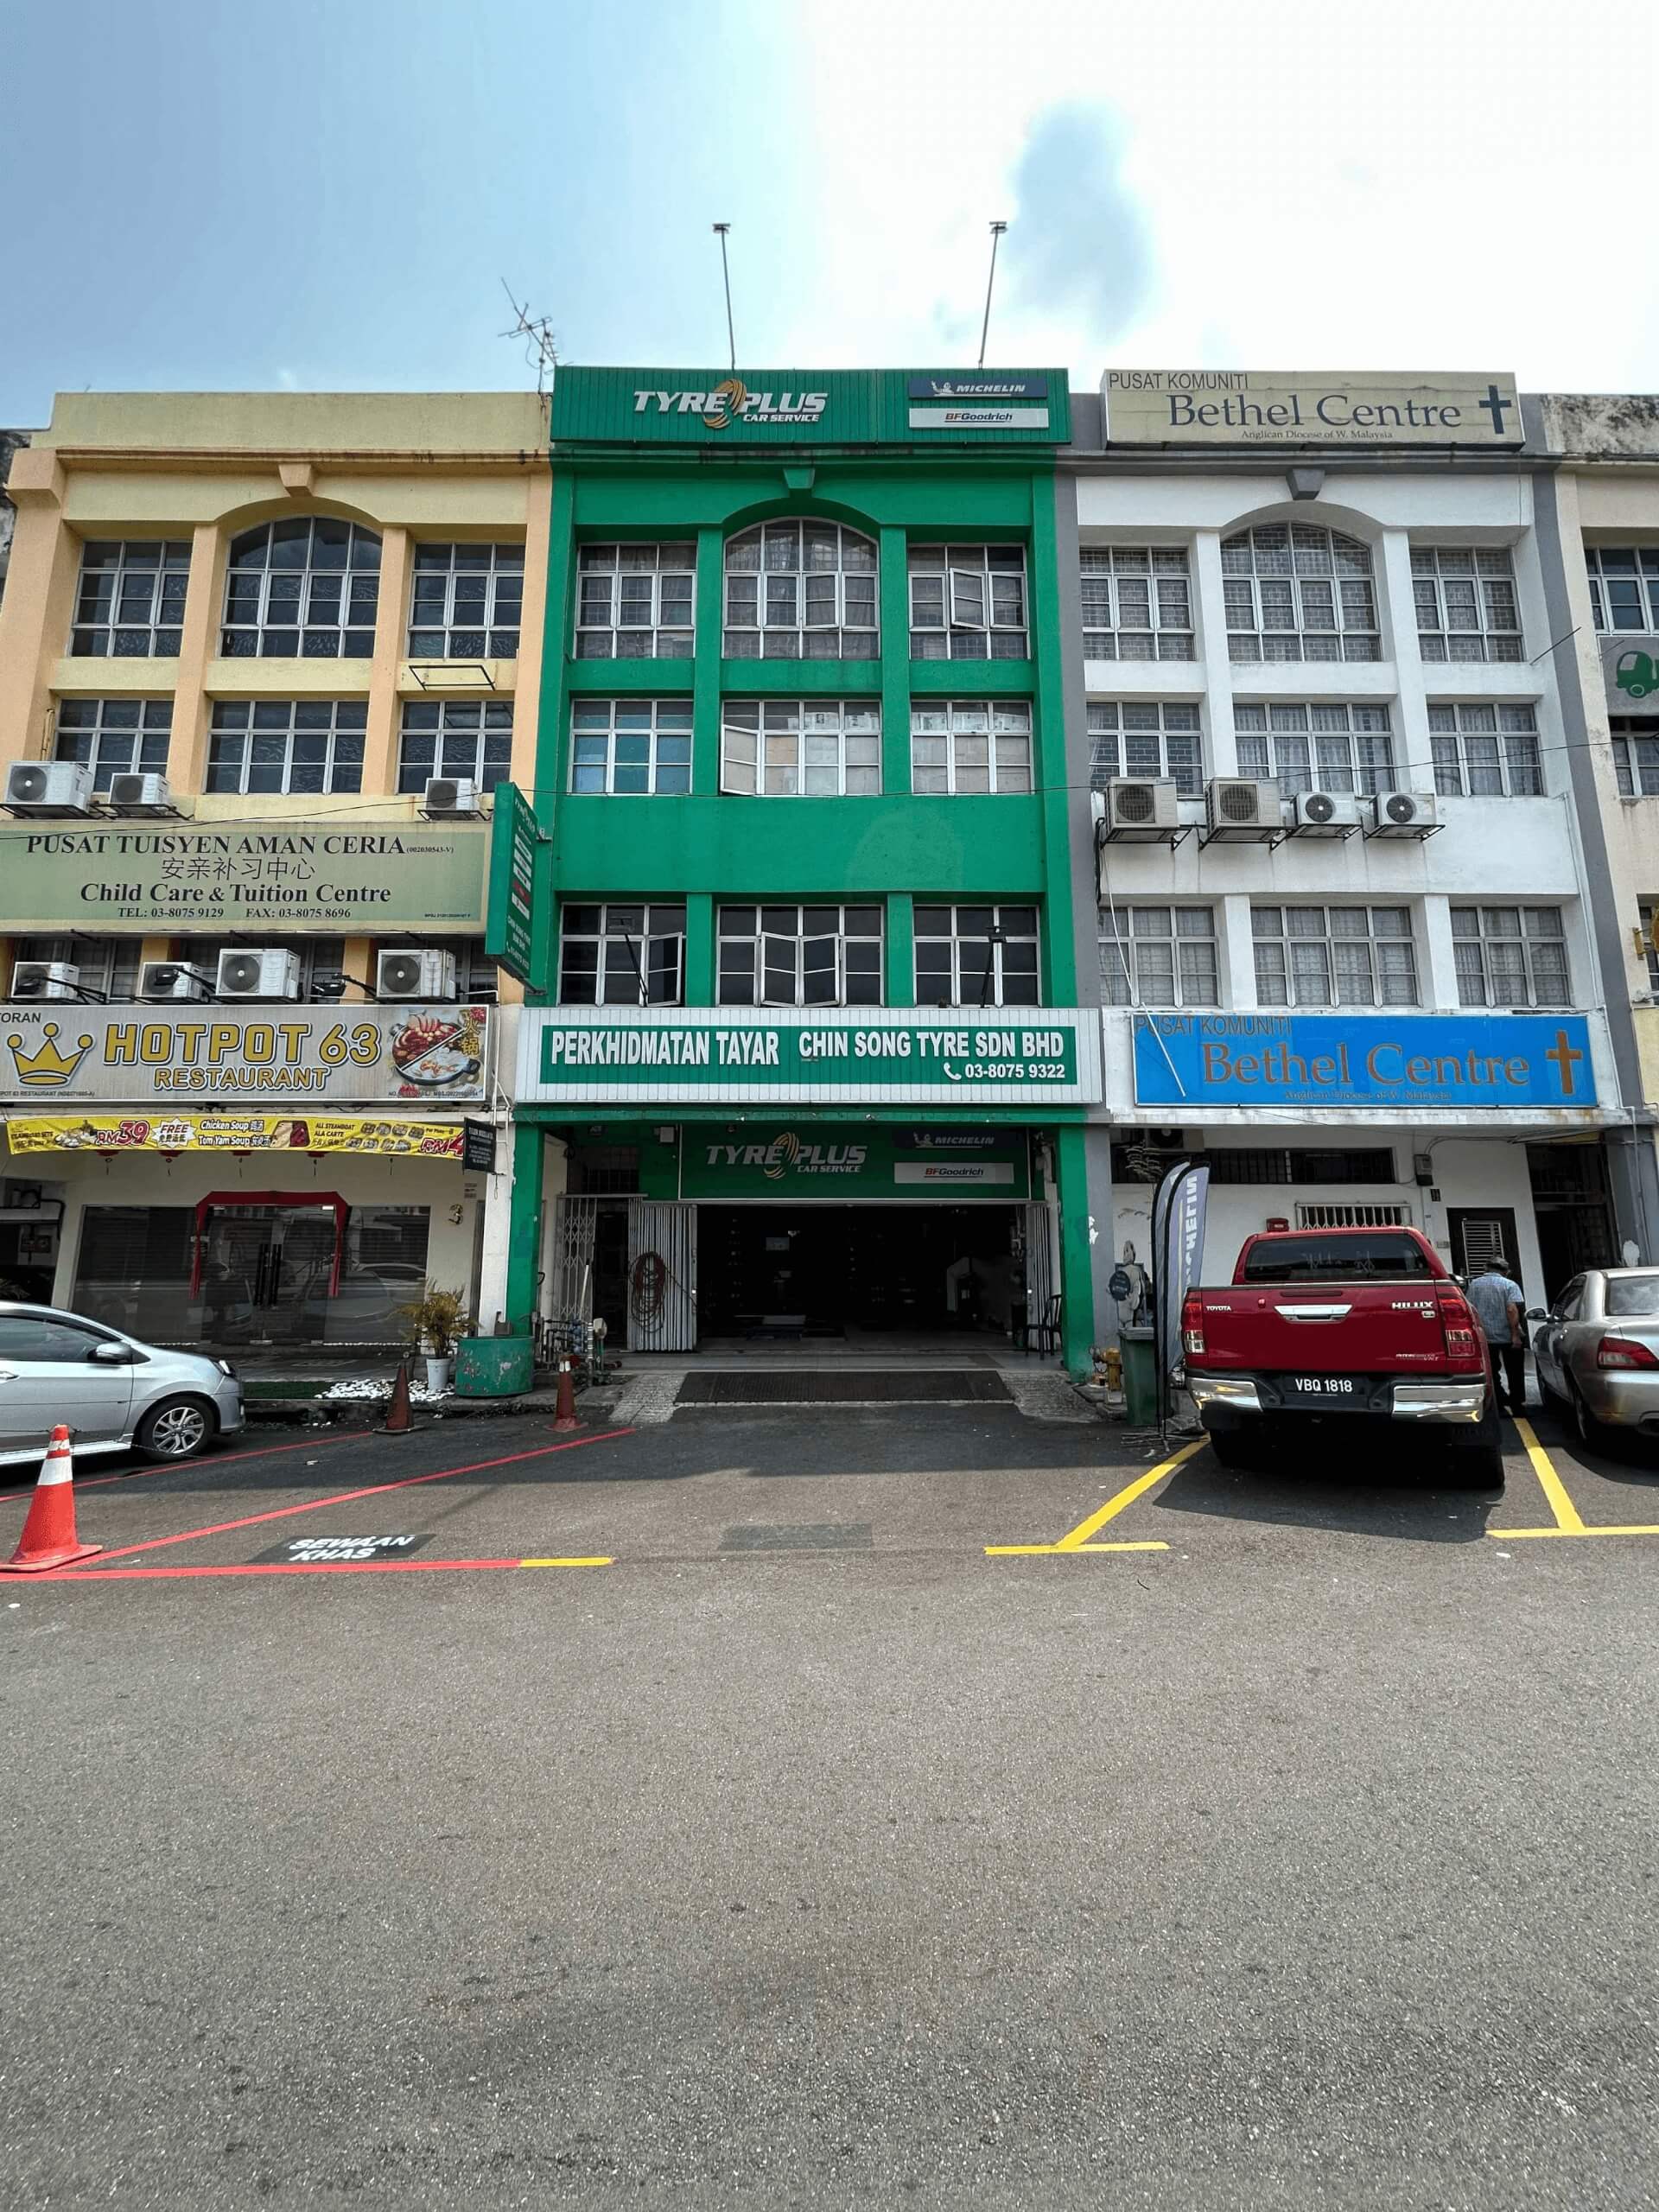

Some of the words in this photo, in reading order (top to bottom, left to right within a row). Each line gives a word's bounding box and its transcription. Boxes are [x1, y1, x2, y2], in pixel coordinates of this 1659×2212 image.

[1109, 373, 1163, 390] PUSAT
[1167, 373, 1249, 390] KOMUNITI
[1166, 394, 1305, 427] Bethel
[1316, 395, 1461, 427] Centre
[743, 414, 768, 423] CAR
[770, 414, 820, 423] SERVICE
[1351, 430, 1393, 440] Malaysia
[27, 835, 111, 854] PUSAT
[117, 836, 231, 854] TUISYEN
[236, 836, 316, 854] AMAN
[323, 836, 405, 855] CERIA
[161, 857, 315, 881] 安亲补习中心
[80, 883, 141, 902] Child
[149, 883, 204, 902] Care
[208, 887, 225, 901] &
[230, 884, 308, 902] Tuition
[316, 883, 391, 902] Centre
[118, 907, 148, 918] TEL:
[151, 907, 194, 918] 03-8075
[198, 907, 225, 918] 9129
[245, 908, 276, 918] FAX:
[278, 908, 323, 918] 03-8075
[325, 907, 351, 918] 8696
[0, 1012, 41, 1023] ORAN
[1135, 1016, 1194, 1035] PUSAT
[1201, 1017, 1293, 1036] KOMUNITI
[103, 1023, 313, 1066] HOTPOT
[319, 1023, 382, 1067] 63
[551, 1032, 709, 1065] PERKHIDMATAN
[715, 1032, 779, 1065] TAYAR
[798, 1032, 848, 1058] CHIN
[853, 1031, 911, 1058] SONG
[916, 1032, 969, 1058] TYRE
[975, 1032, 1016, 1058] SDN
[1022, 1032, 1064, 1058] BHD
[964, 1064, 1025, 1078] 03-8075
[1028, 1064, 1065, 1078] 9322
[1202, 1042, 1352, 1084] Bethel
[1367, 1043, 1529, 1085] Centre
[154, 1067, 331, 1090] RESTAURANT
[160, 1124, 189, 1134] FREE
[200, 1121, 230, 1130] Chicken
[232, 1122, 249, 1131] Soup
[200, 1135, 213, 1145] Tom
[215, 1135, 230, 1145] Yam
[232, 1135, 250, 1146] Soup
[934, 1136, 995, 1145] MICHELIN
[925, 1167, 984, 1176] BFGoodrich
[1294, 1378, 1322, 1392] VBQ
[1324, 1379, 1353, 1393] 1818
[289, 1535, 416, 1550] SEWAAN
[289, 1548, 377, 1561] KHAS
